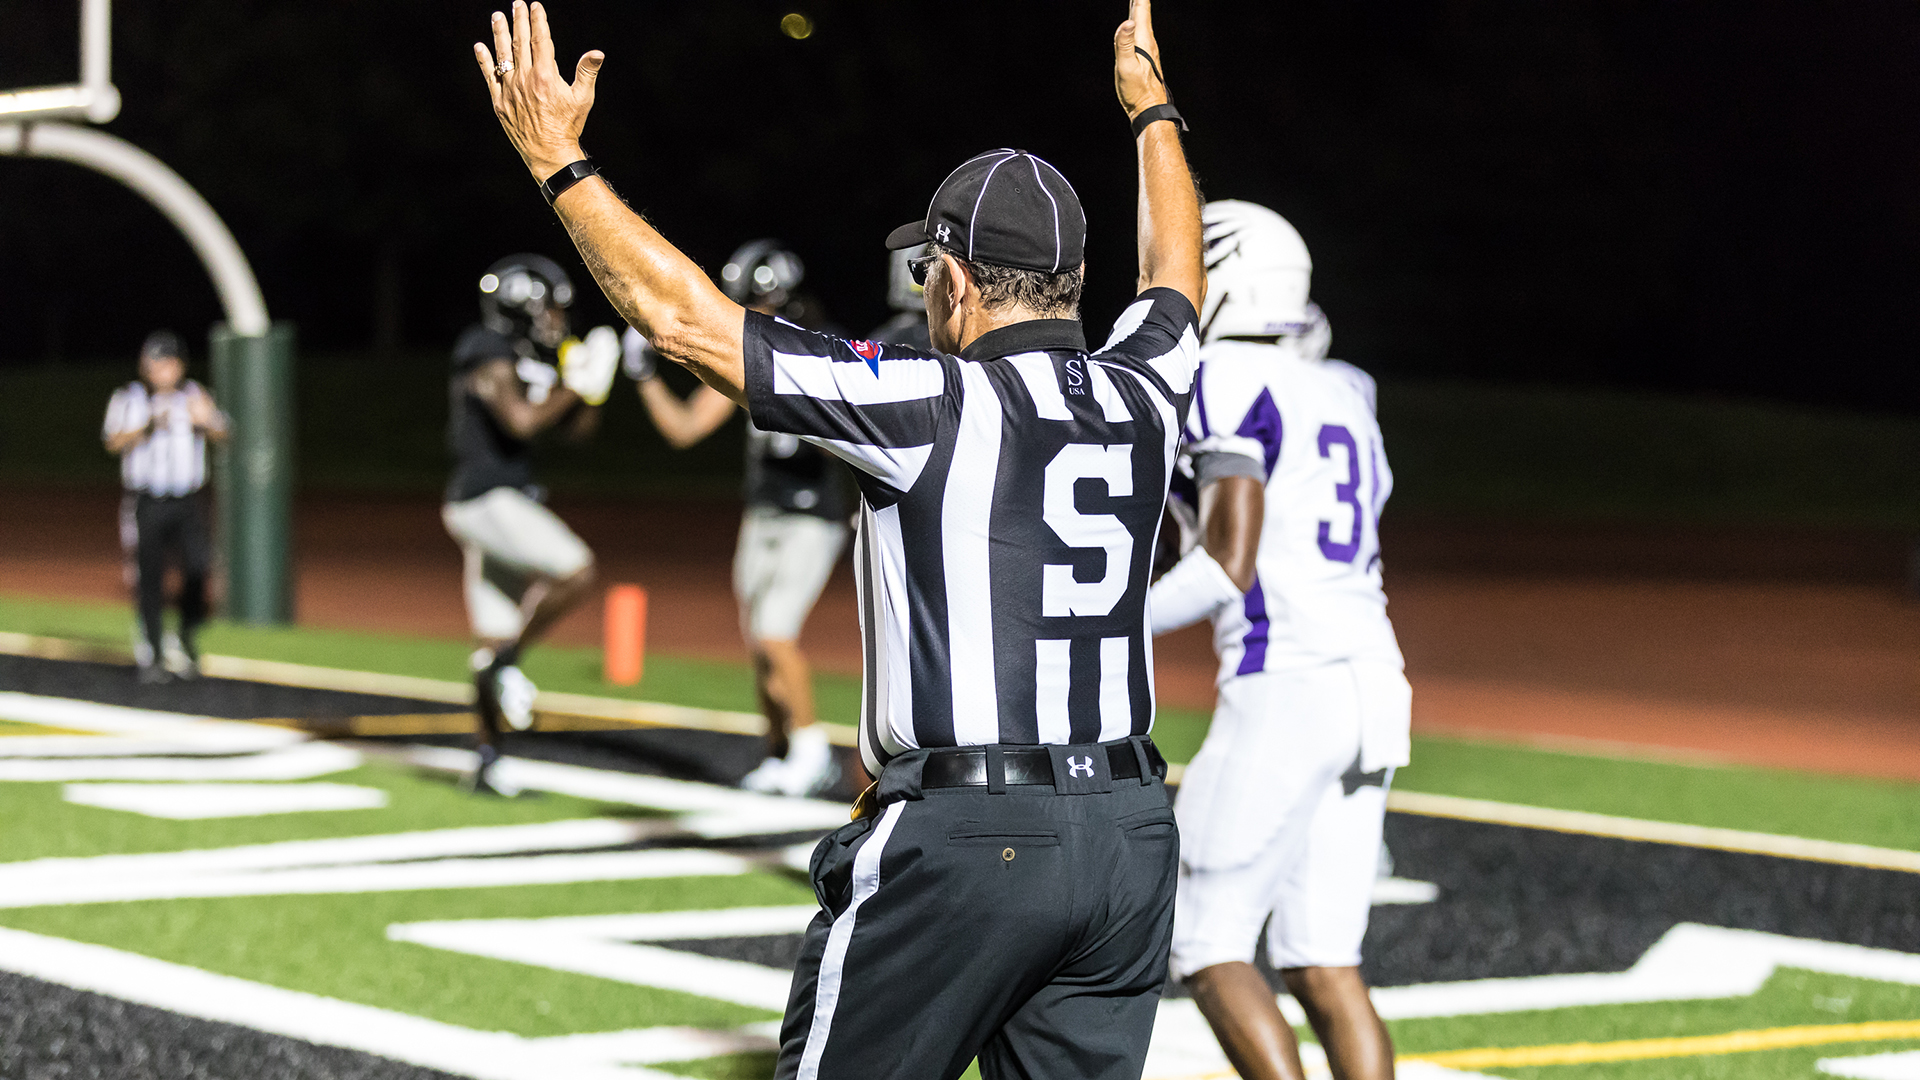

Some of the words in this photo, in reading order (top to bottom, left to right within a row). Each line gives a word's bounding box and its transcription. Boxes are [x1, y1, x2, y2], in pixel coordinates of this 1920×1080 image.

[1065, 359, 1084, 387] S
[1068, 387, 1085, 396] USA
[1042, 443, 1134, 617] S
[1317, 423, 1380, 564] 3
